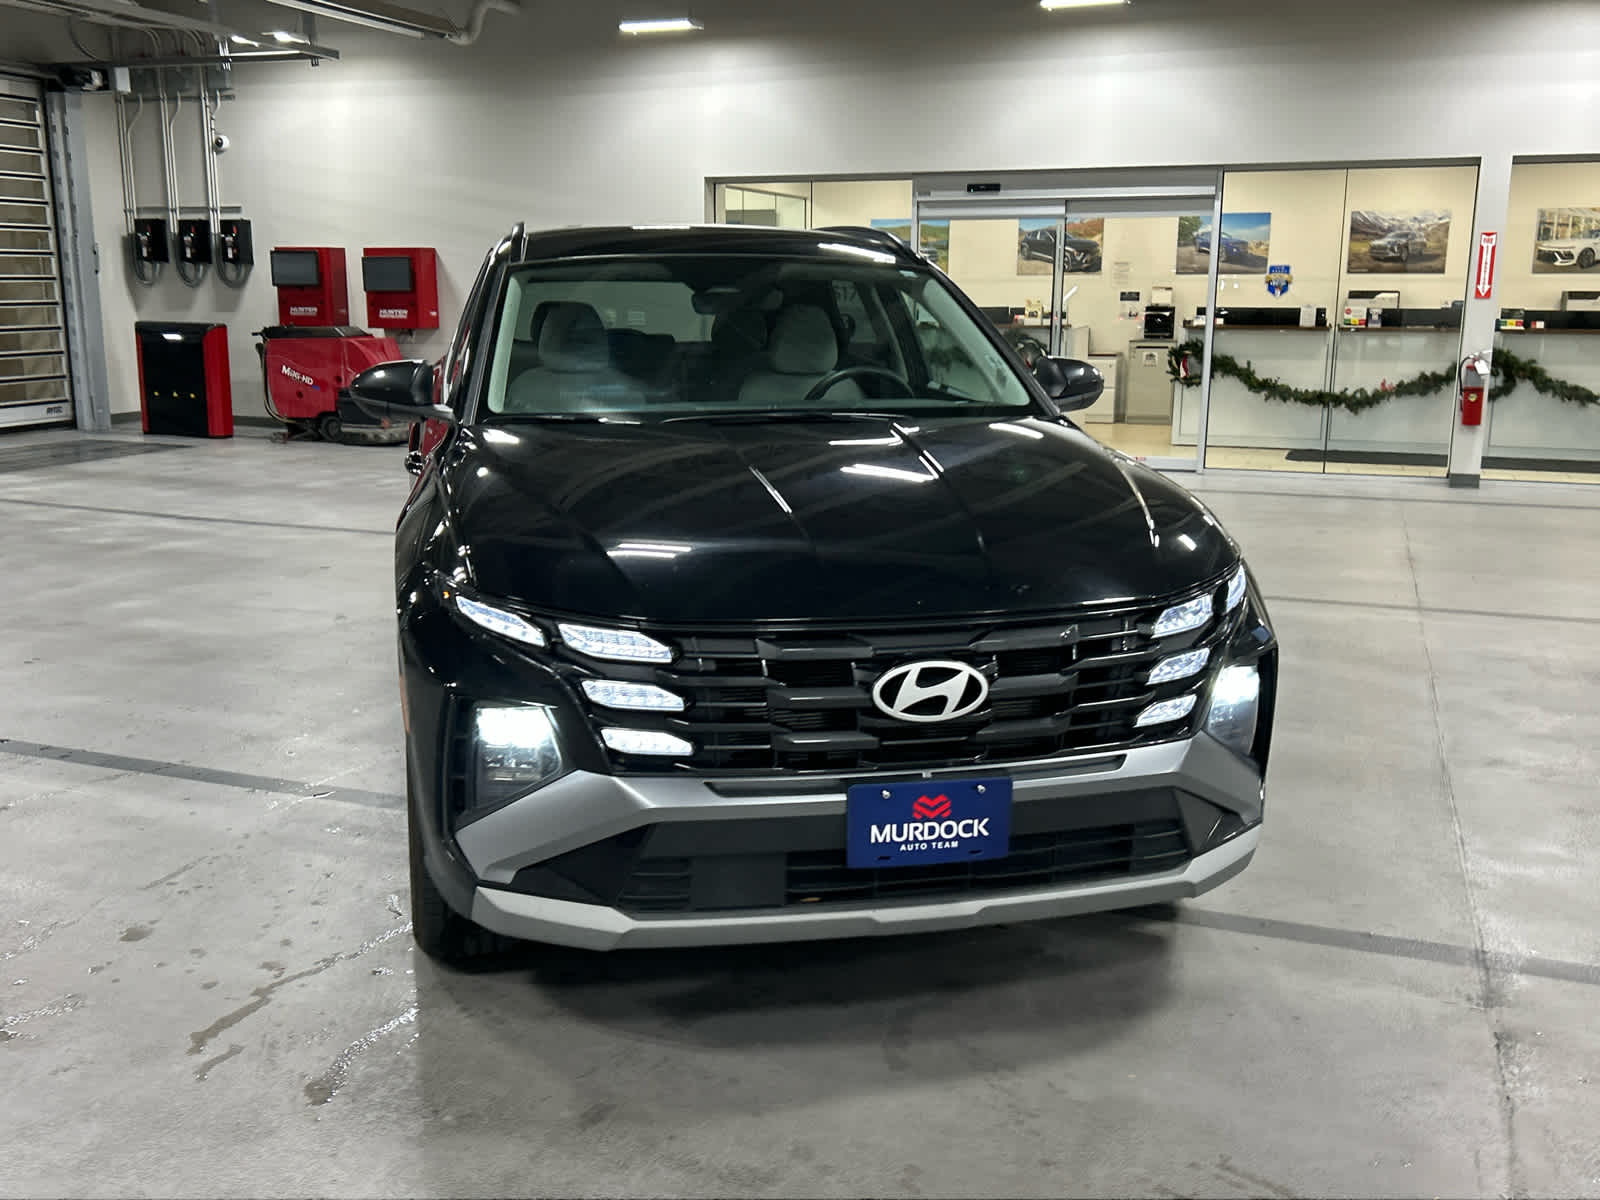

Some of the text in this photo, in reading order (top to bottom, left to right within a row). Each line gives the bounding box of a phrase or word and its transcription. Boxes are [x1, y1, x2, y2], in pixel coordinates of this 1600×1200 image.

[870, 818, 990, 843] MURDOCK
[899, 840, 959, 851] AUTO TEAM
